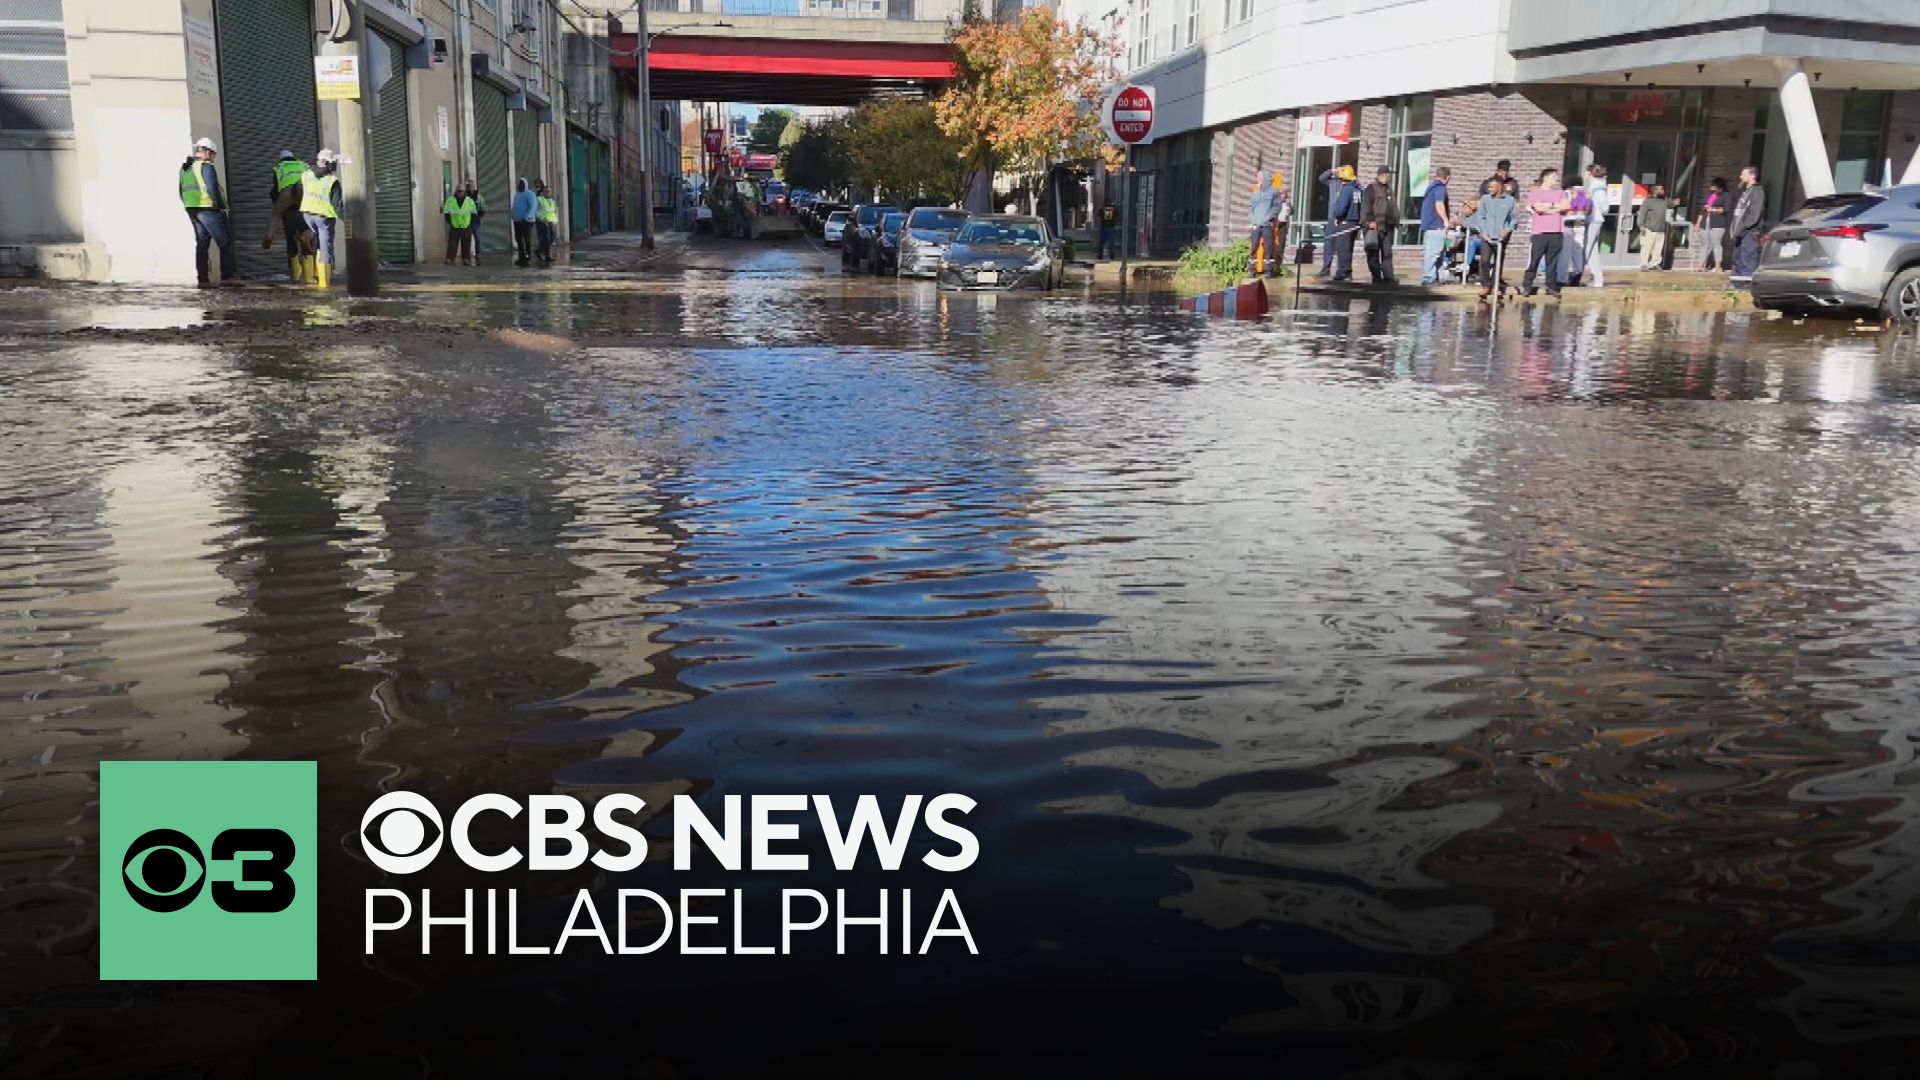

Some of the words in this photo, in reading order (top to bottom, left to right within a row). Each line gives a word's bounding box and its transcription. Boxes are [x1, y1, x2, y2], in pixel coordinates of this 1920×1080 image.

[1118, 97, 1129, 107] DO
[1132, 97, 1148, 108] NOT
[1120, 122, 1145, 133] ENTER
